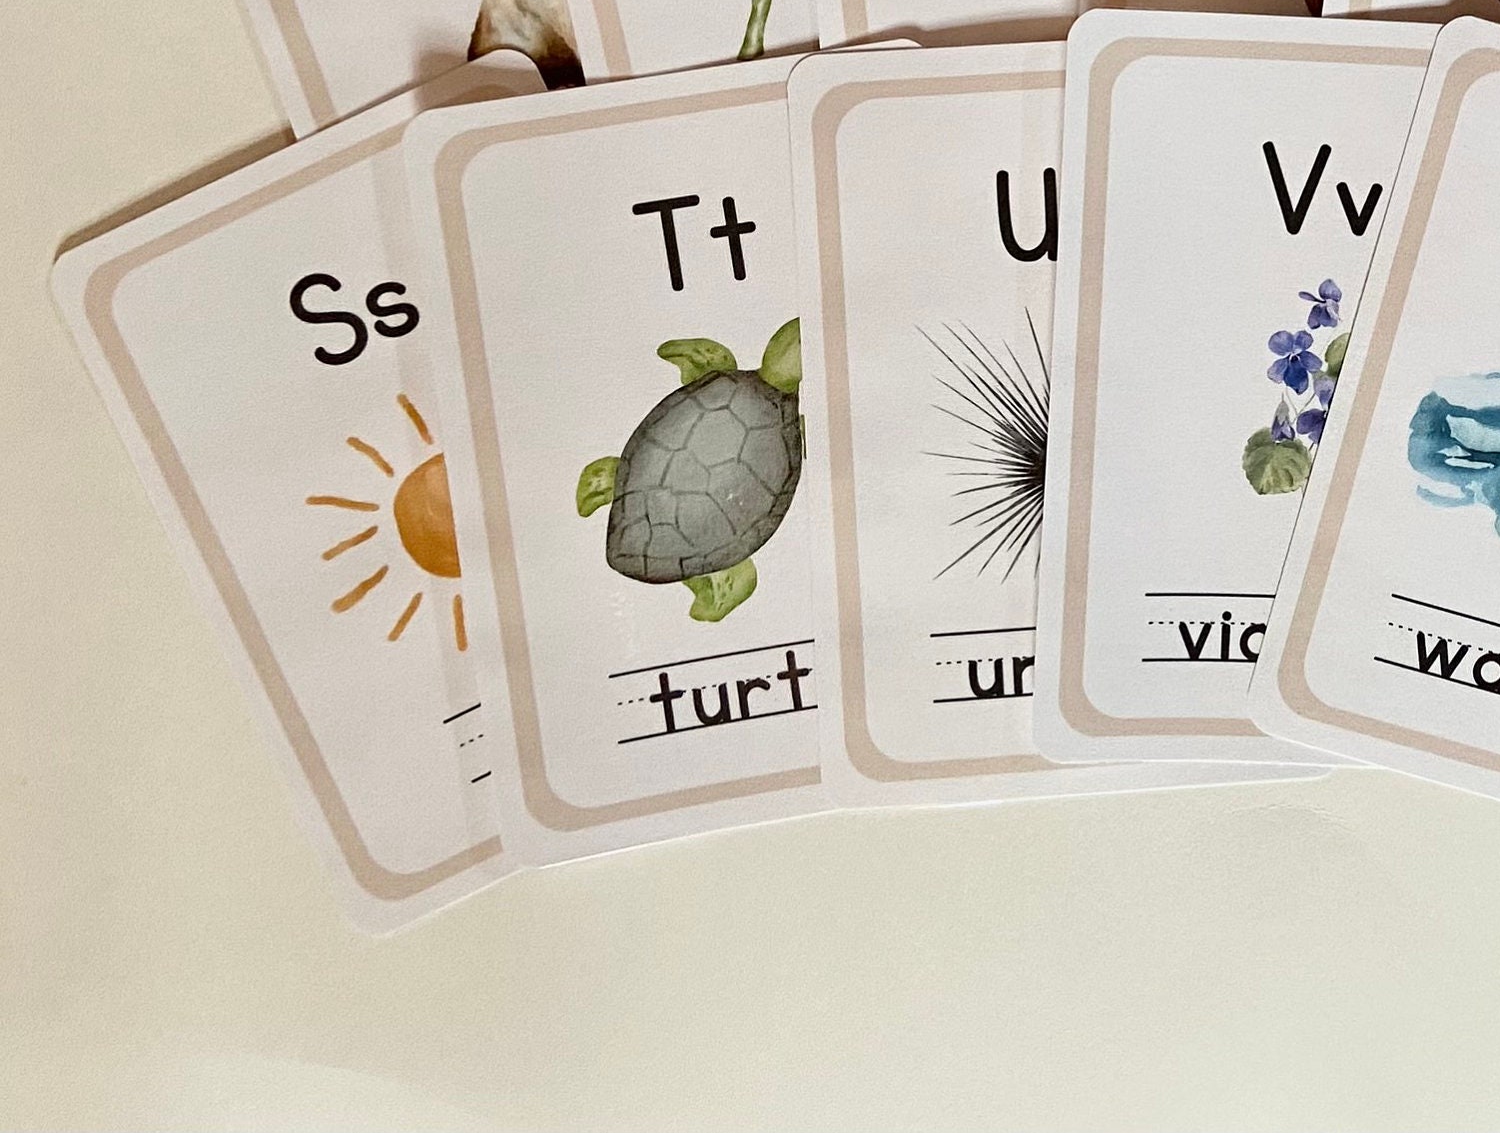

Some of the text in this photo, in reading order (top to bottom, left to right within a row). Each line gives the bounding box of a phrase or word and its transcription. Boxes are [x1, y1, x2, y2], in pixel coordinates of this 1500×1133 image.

[997, 168, 1058, 261] U
[1263, 142, 1383, 236] Vv
[633, 195, 756, 291] Tt
[290, 274, 419, 365] Ss
[649, 650, 810, 732] turt
